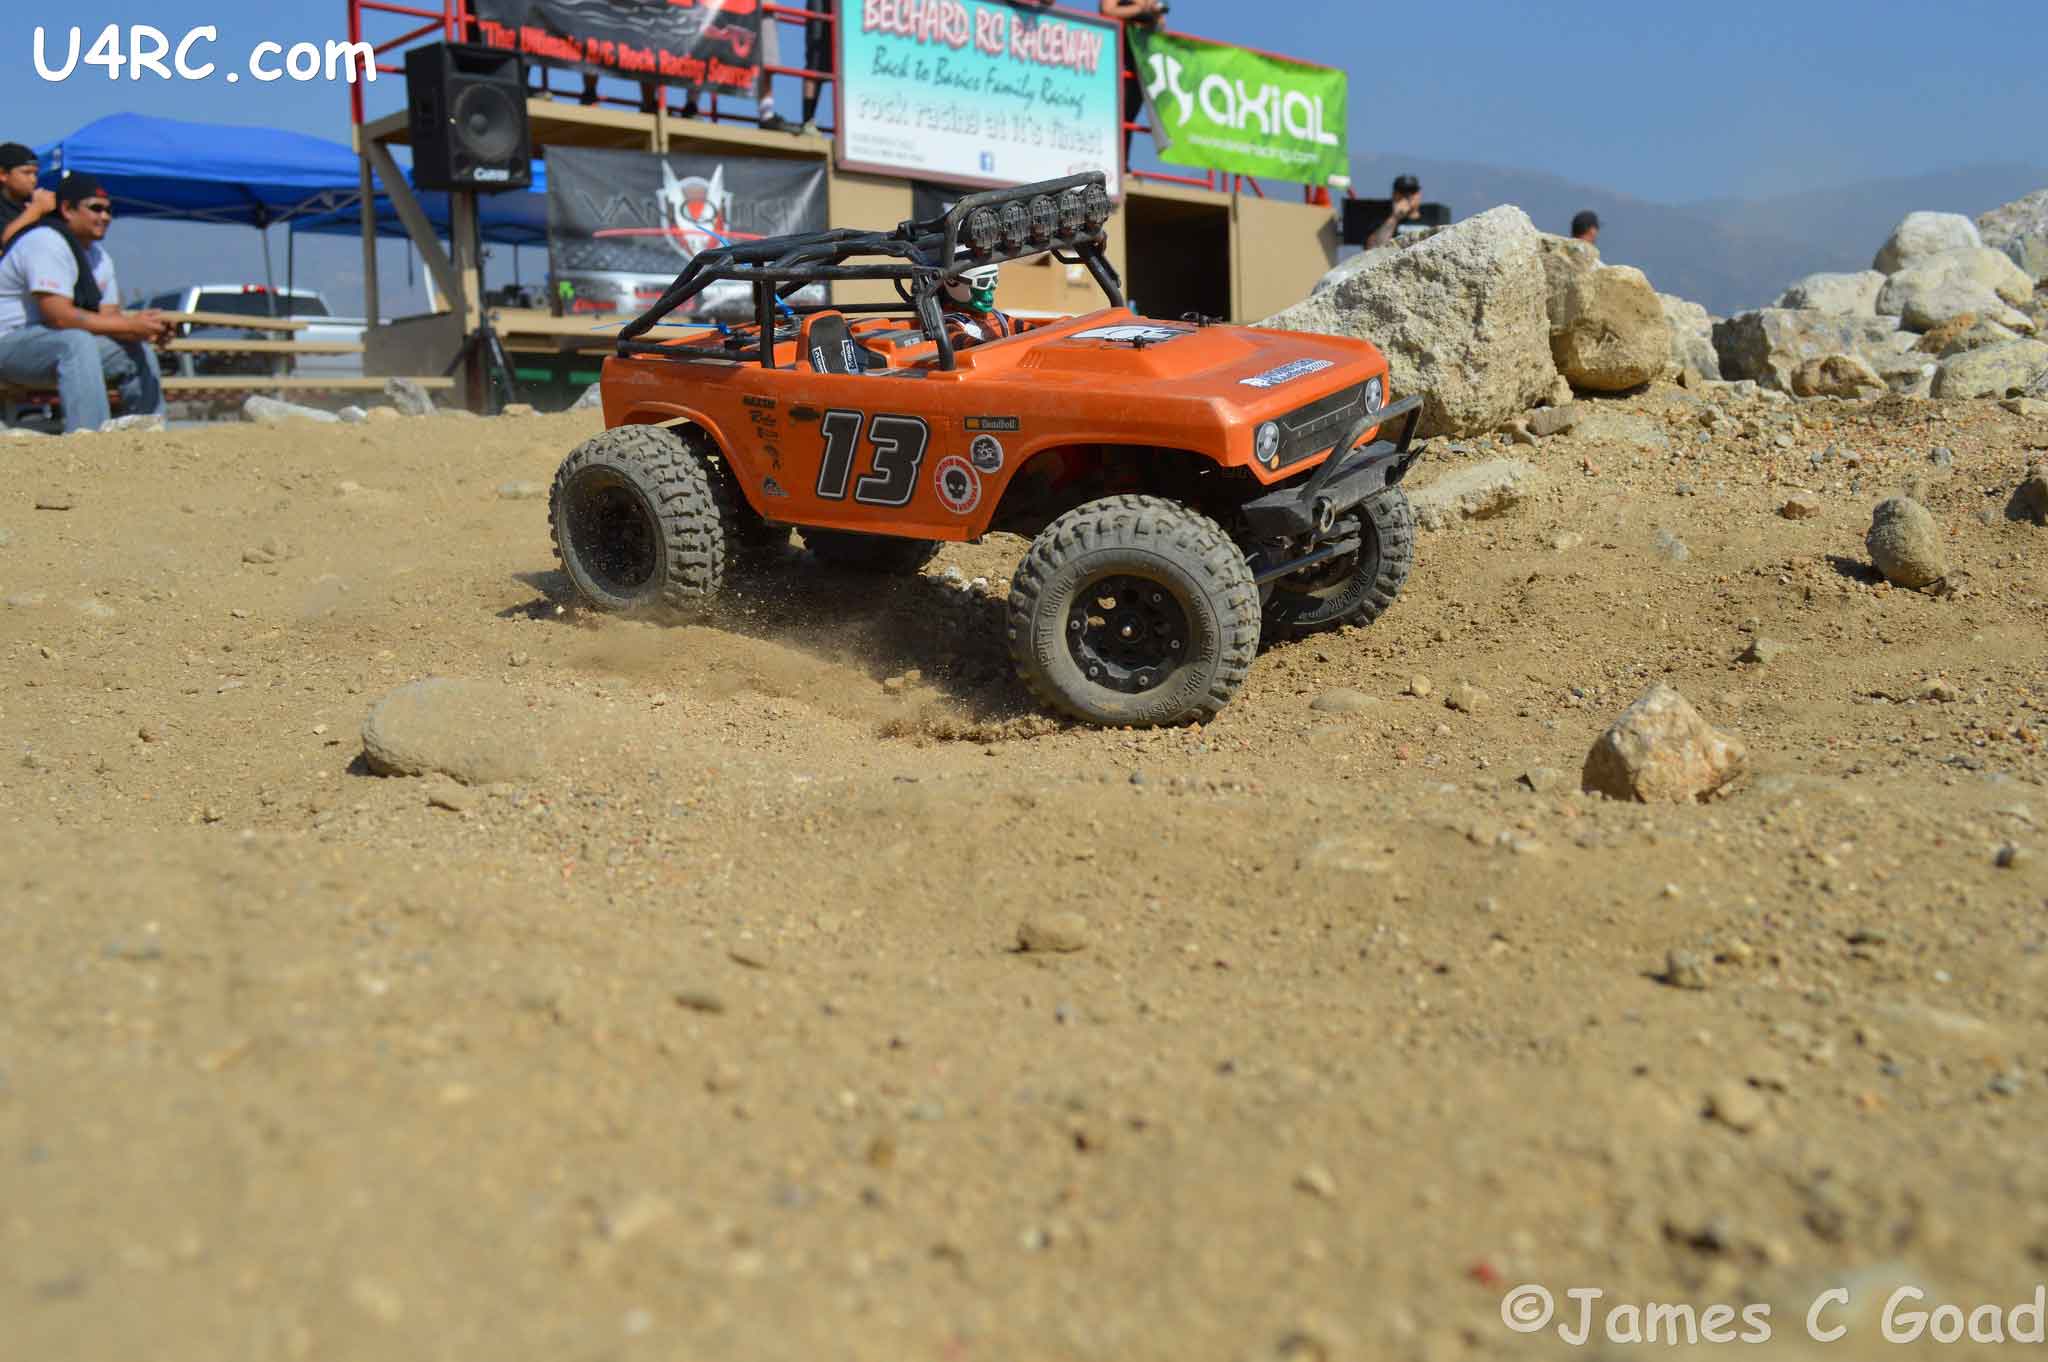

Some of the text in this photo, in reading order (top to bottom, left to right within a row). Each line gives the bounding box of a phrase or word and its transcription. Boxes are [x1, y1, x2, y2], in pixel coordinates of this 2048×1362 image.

[863, 0, 1103, 75] BECHARD RC RACEWAY
[871, 46, 1085, 119] Back to Basics Family Racing
[816, 408, 932, 507] 13
